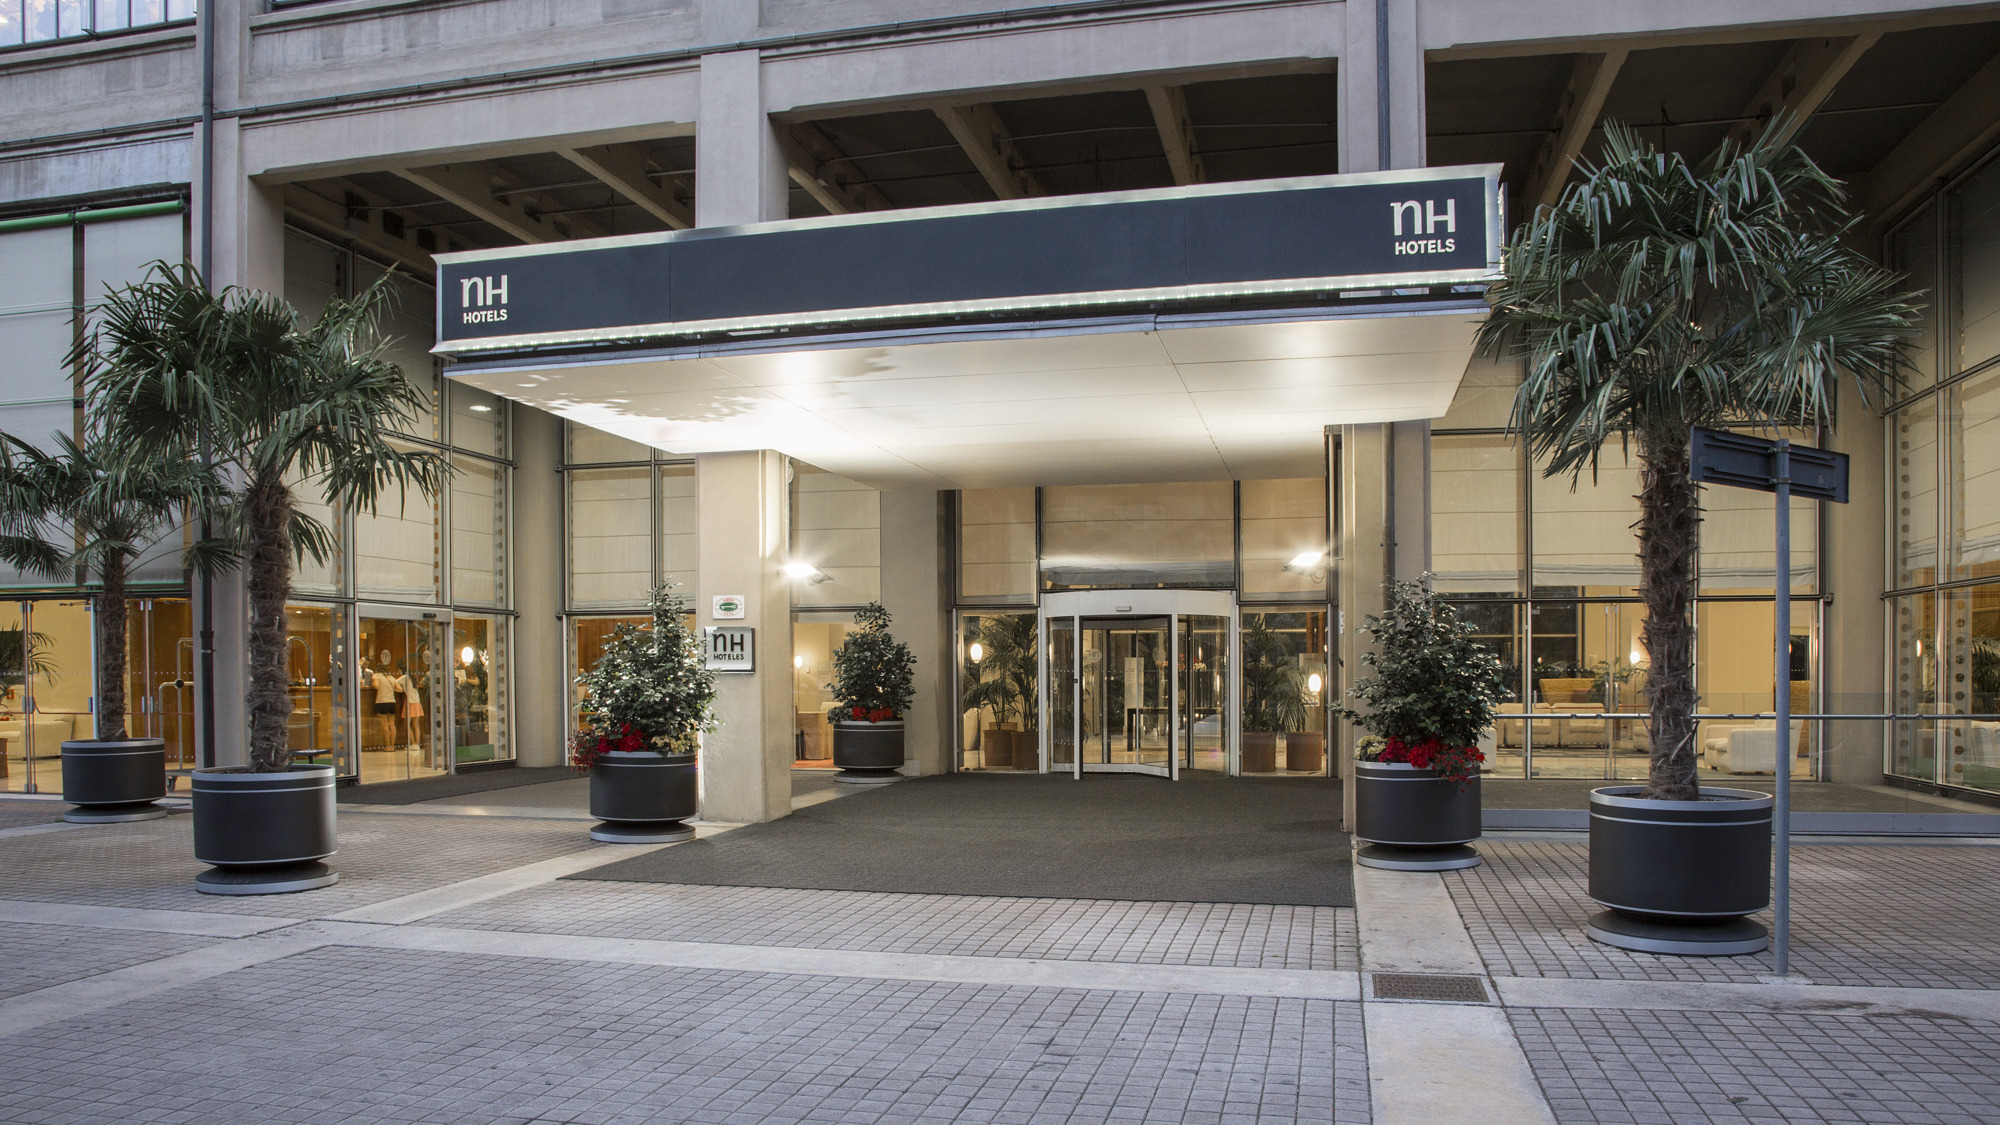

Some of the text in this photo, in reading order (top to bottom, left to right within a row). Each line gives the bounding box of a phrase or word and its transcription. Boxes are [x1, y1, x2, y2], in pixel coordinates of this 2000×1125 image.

[1390, 199, 1456, 236] nH
[1394, 238, 1456, 255] HOTELS
[460, 274, 508, 308] nH
[463, 309, 508, 324] HOTELS
[712, 633, 745, 652] nH
[713, 653, 745, 661] HOTELES
